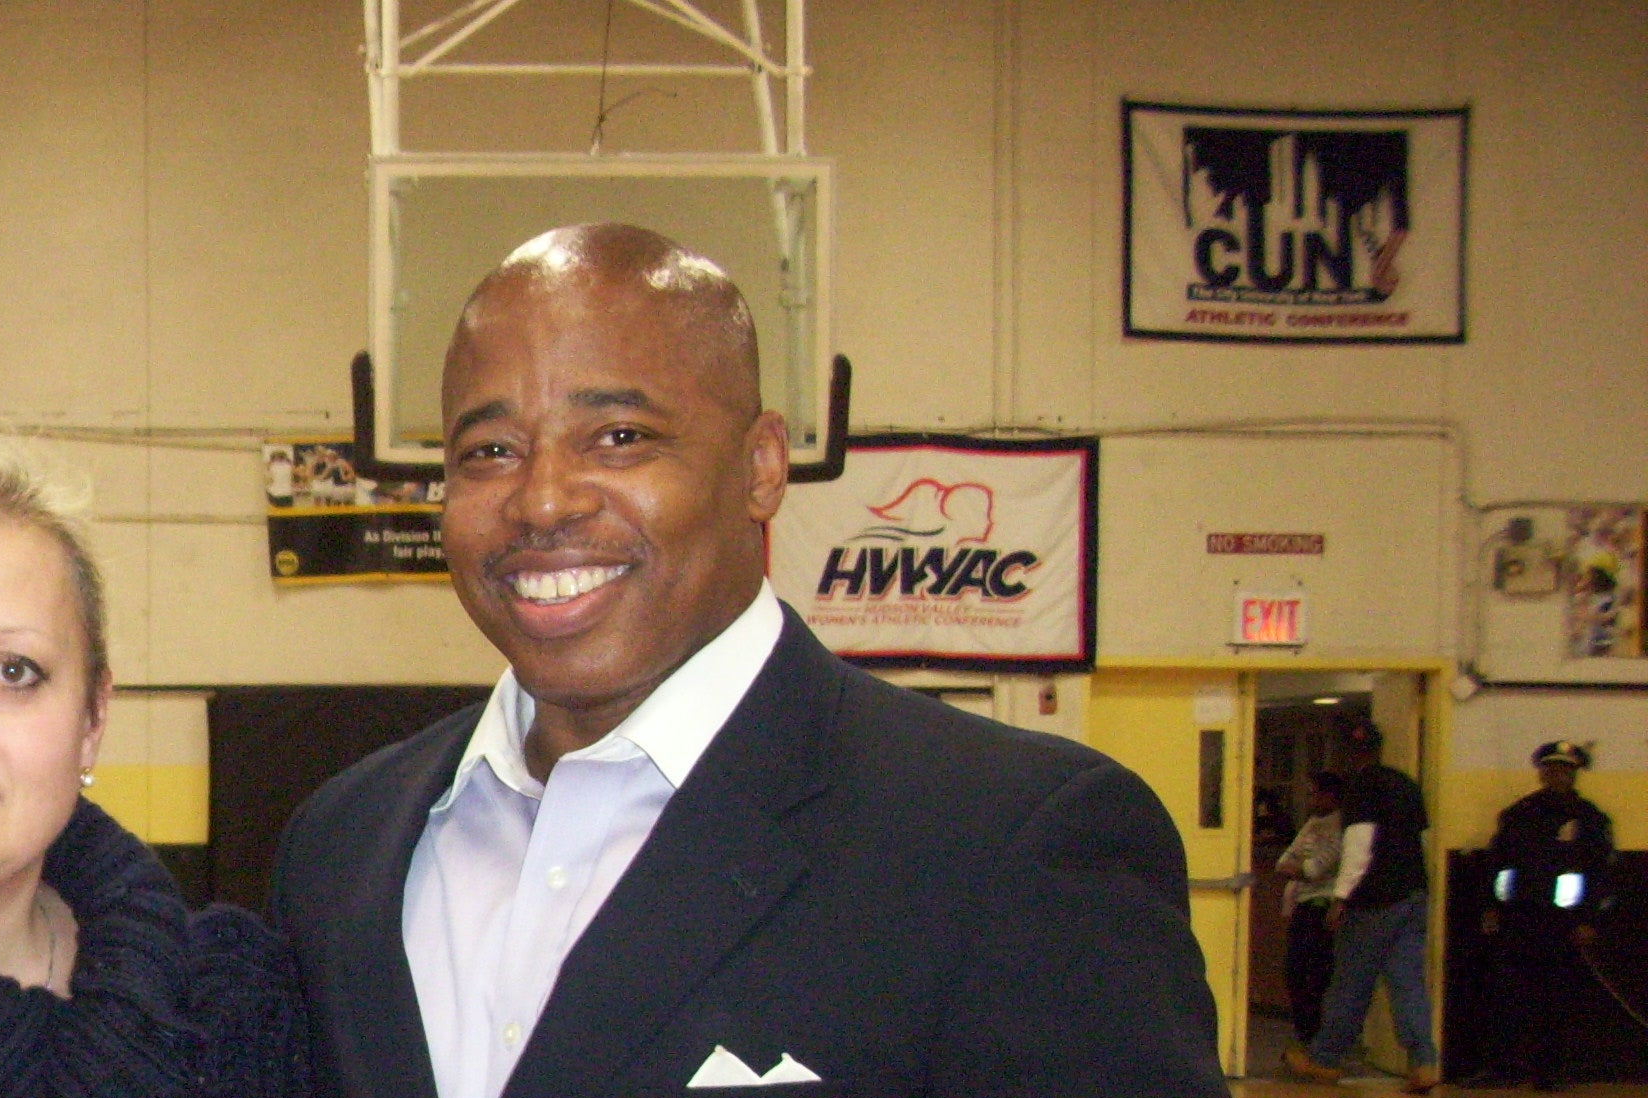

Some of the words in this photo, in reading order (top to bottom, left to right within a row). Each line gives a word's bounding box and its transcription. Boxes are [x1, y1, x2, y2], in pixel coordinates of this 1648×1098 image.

[1185, 309, 1275, 325] ATHLETIC
[1286, 312, 1410, 327] CONFERENCE
[933, 615, 1022, 627] CONFERENCE
[1241, 599, 1301, 641] EXIT
